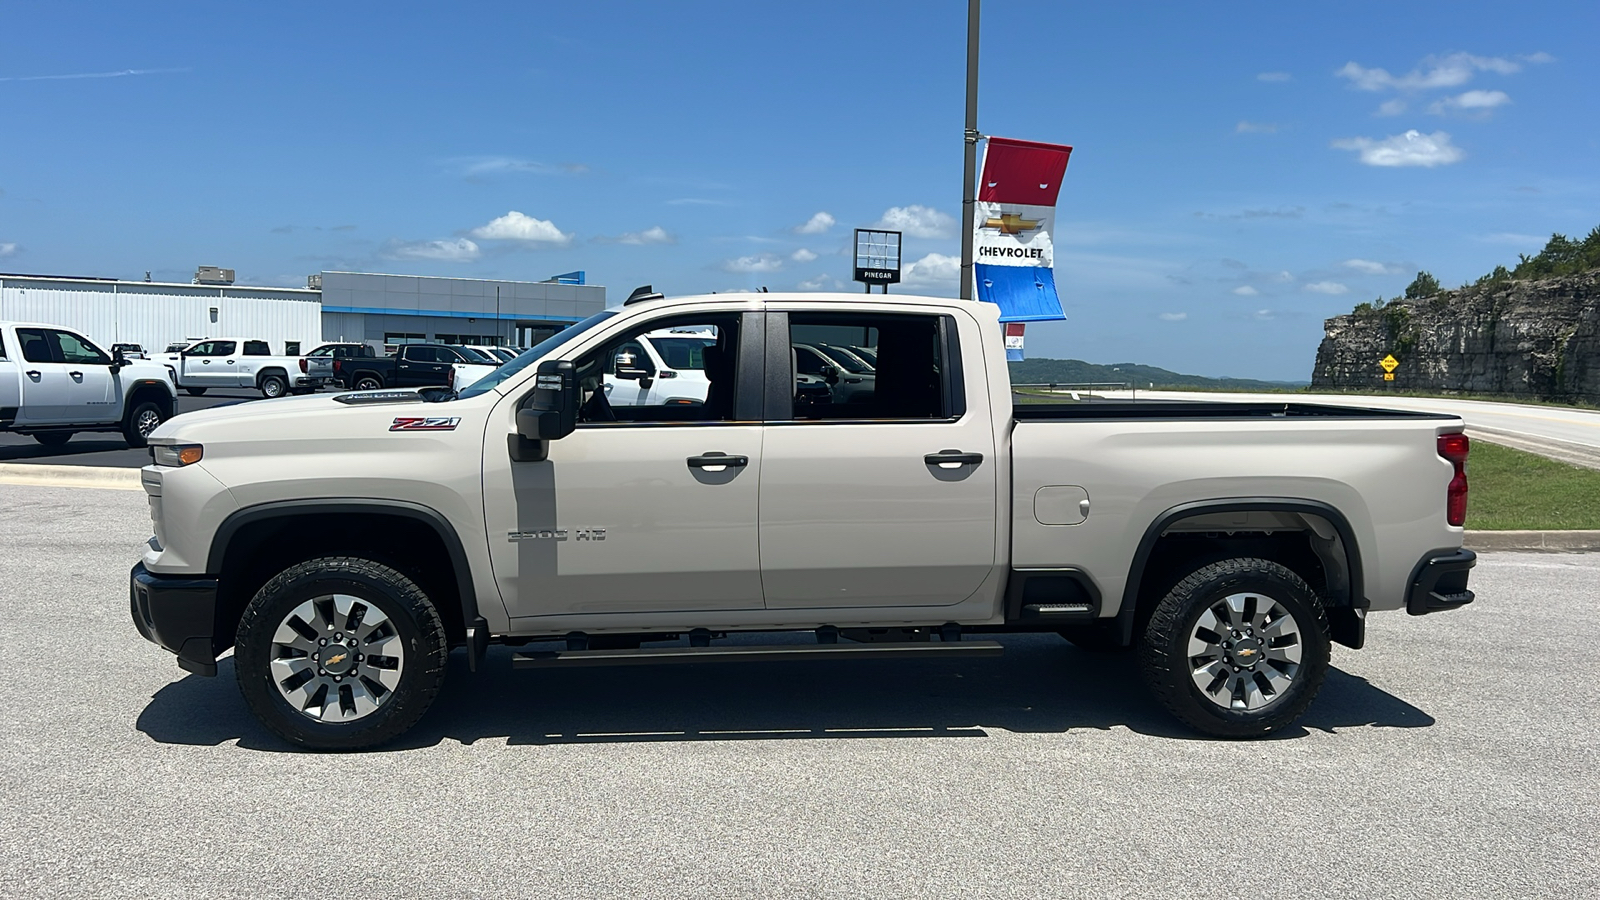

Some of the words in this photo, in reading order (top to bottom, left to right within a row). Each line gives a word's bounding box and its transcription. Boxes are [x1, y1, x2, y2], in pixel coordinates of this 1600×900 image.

[979, 246, 1044, 259] CHEVROLET
[864, 271, 892, 279] PINEGAR
[388, 417, 461, 431] Z71
